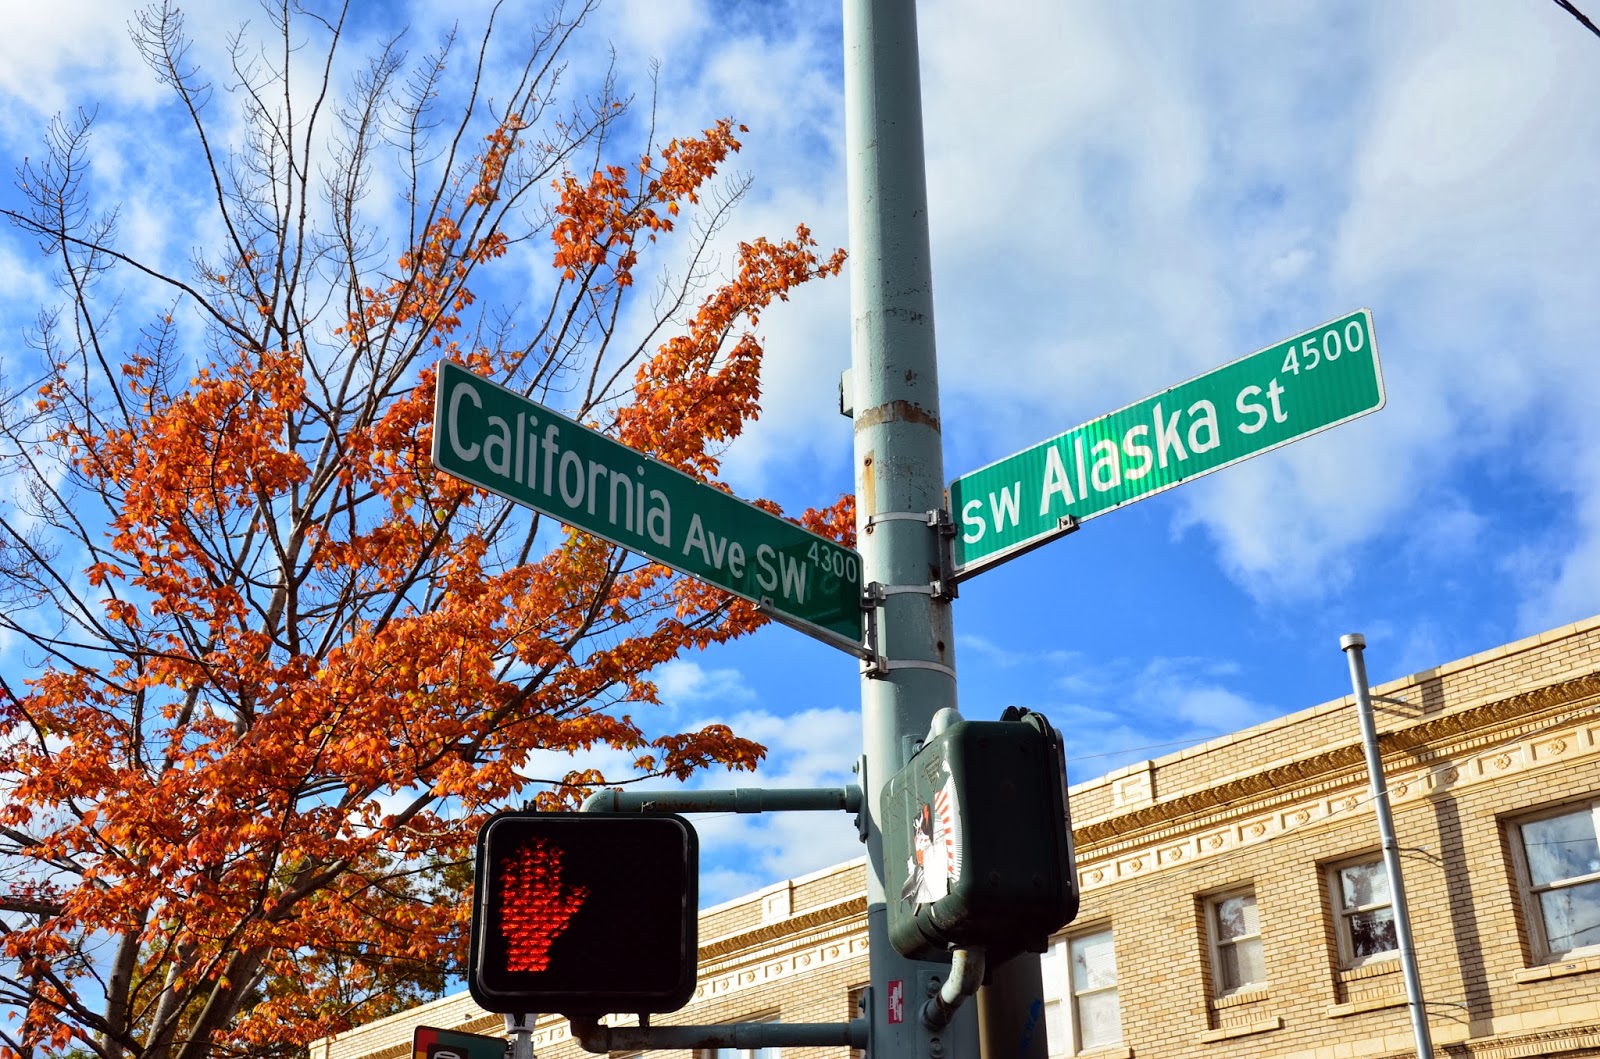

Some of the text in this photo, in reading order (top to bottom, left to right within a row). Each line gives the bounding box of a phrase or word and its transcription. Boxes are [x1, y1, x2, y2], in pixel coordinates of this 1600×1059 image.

[1281, 320, 1365, 376] 4500
[448, 382, 807, 605] California Ave SW
[962, 377, 1289, 544] SW Alaska St
[807, 541, 857, 583] 4300
